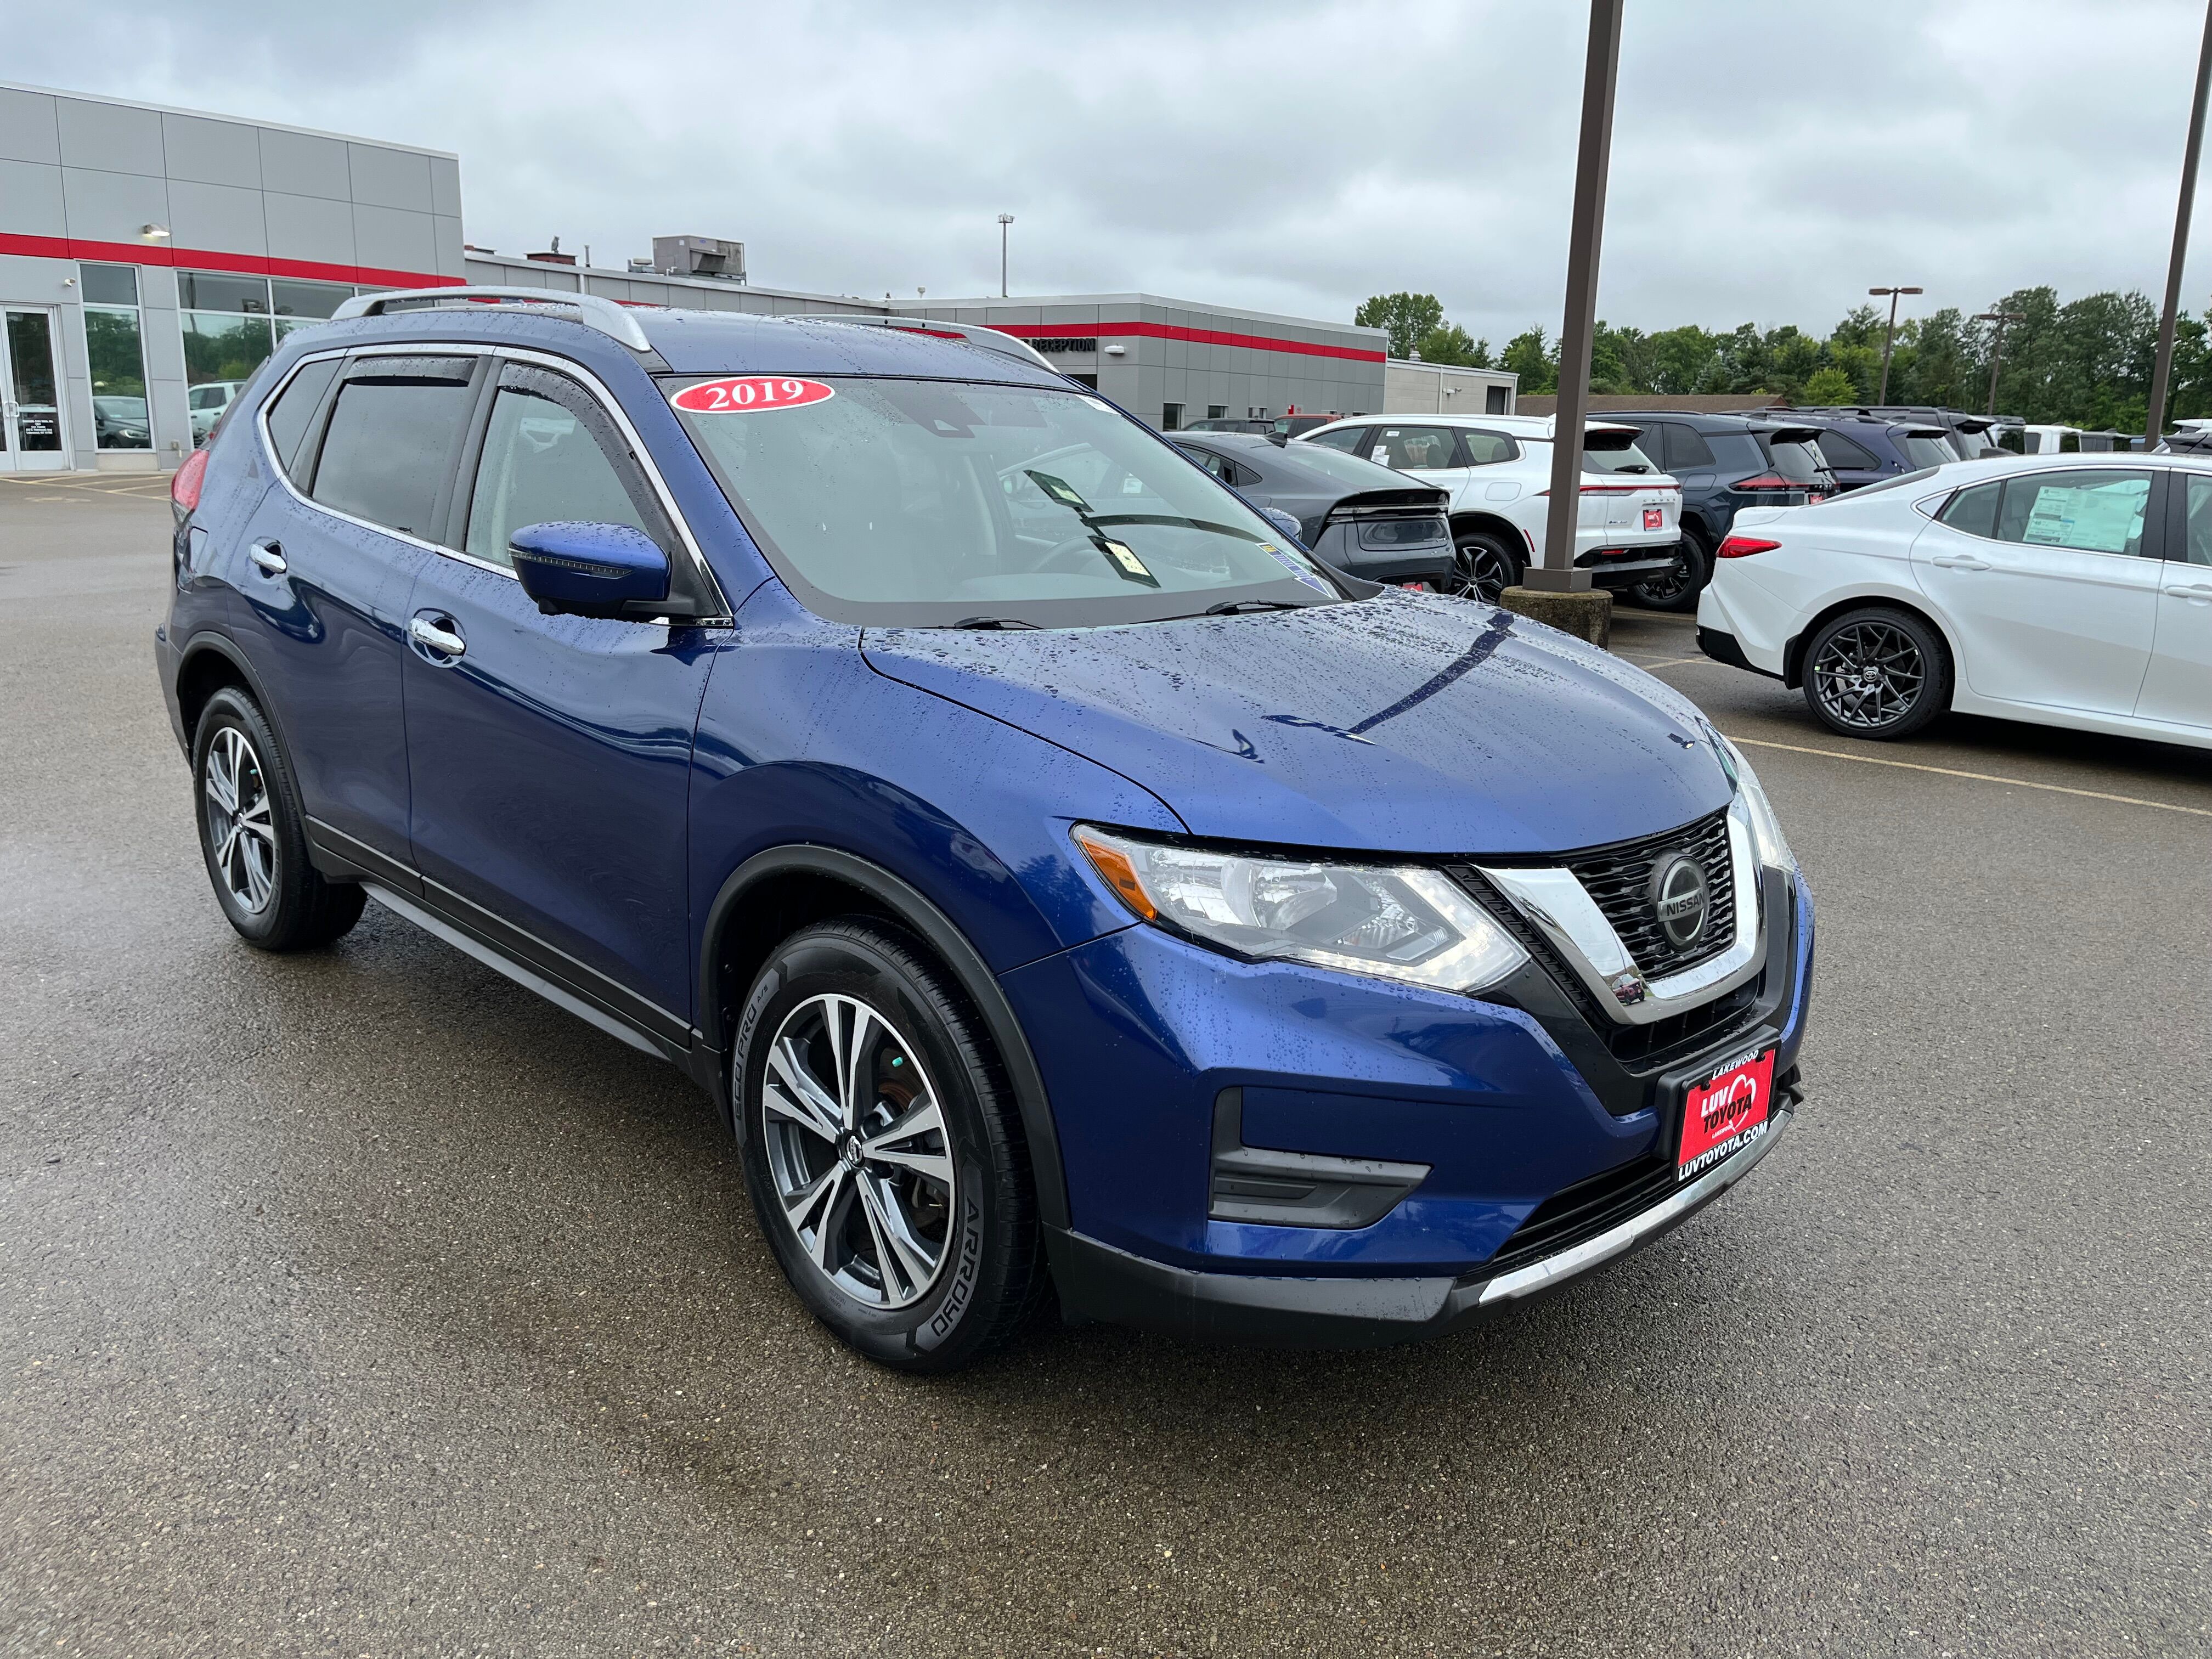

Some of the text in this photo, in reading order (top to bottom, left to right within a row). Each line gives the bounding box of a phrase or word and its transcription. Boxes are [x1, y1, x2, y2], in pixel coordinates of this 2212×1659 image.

[1032, 338, 1096, 352] RECEPTION
[706, 380, 804, 409] 2019
[1667, 891, 1704, 916] NISSAN
[737, 1003, 757, 1059] PRO
[757, 985, 768, 1003] A/S
[1712, 1049, 1759, 1080] LAKEWOOD
[1701, 1086, 1729, 1118] LUV
[1703, 1094, 1751, 1134] TOYOTA
[1712, 1123, 1734, 1139] LAKEWOOD
[1678, 1121, 1768, 1181] LUVTOYOTA.COM
[931, 1195, 979, 1337] ARROYO
